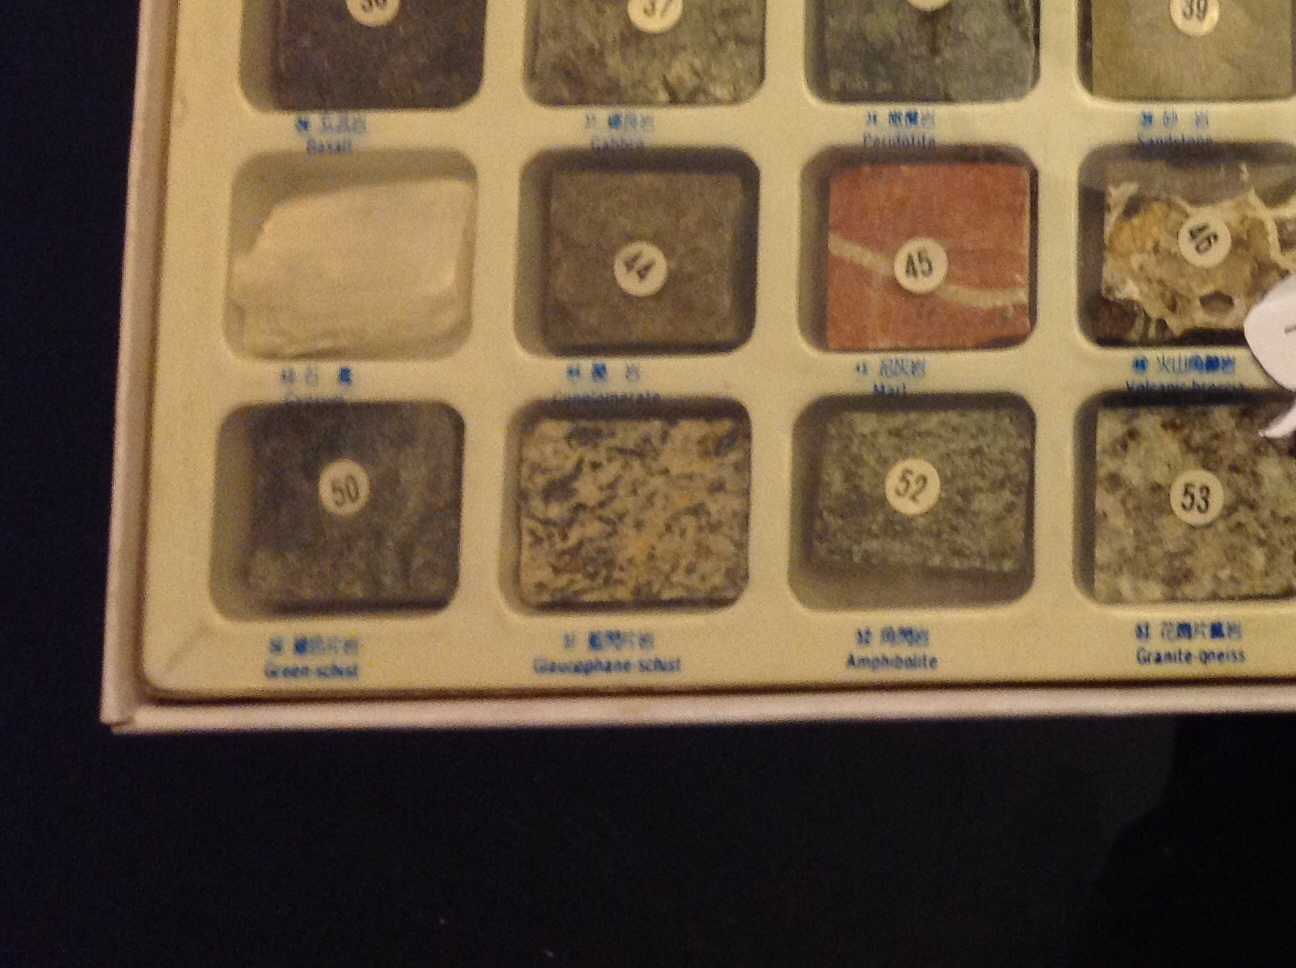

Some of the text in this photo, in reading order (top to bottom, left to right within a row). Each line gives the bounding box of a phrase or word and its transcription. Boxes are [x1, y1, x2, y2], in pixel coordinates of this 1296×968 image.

[1189, 222, 1219, 255] 46
[624, 253, 656, 283] 44
[905, 250, 933, 279] 45
[331, 475, 360, 508] 50
[894, 468, 928, 504] 52
[1180, 481, 1211, 514] 53
